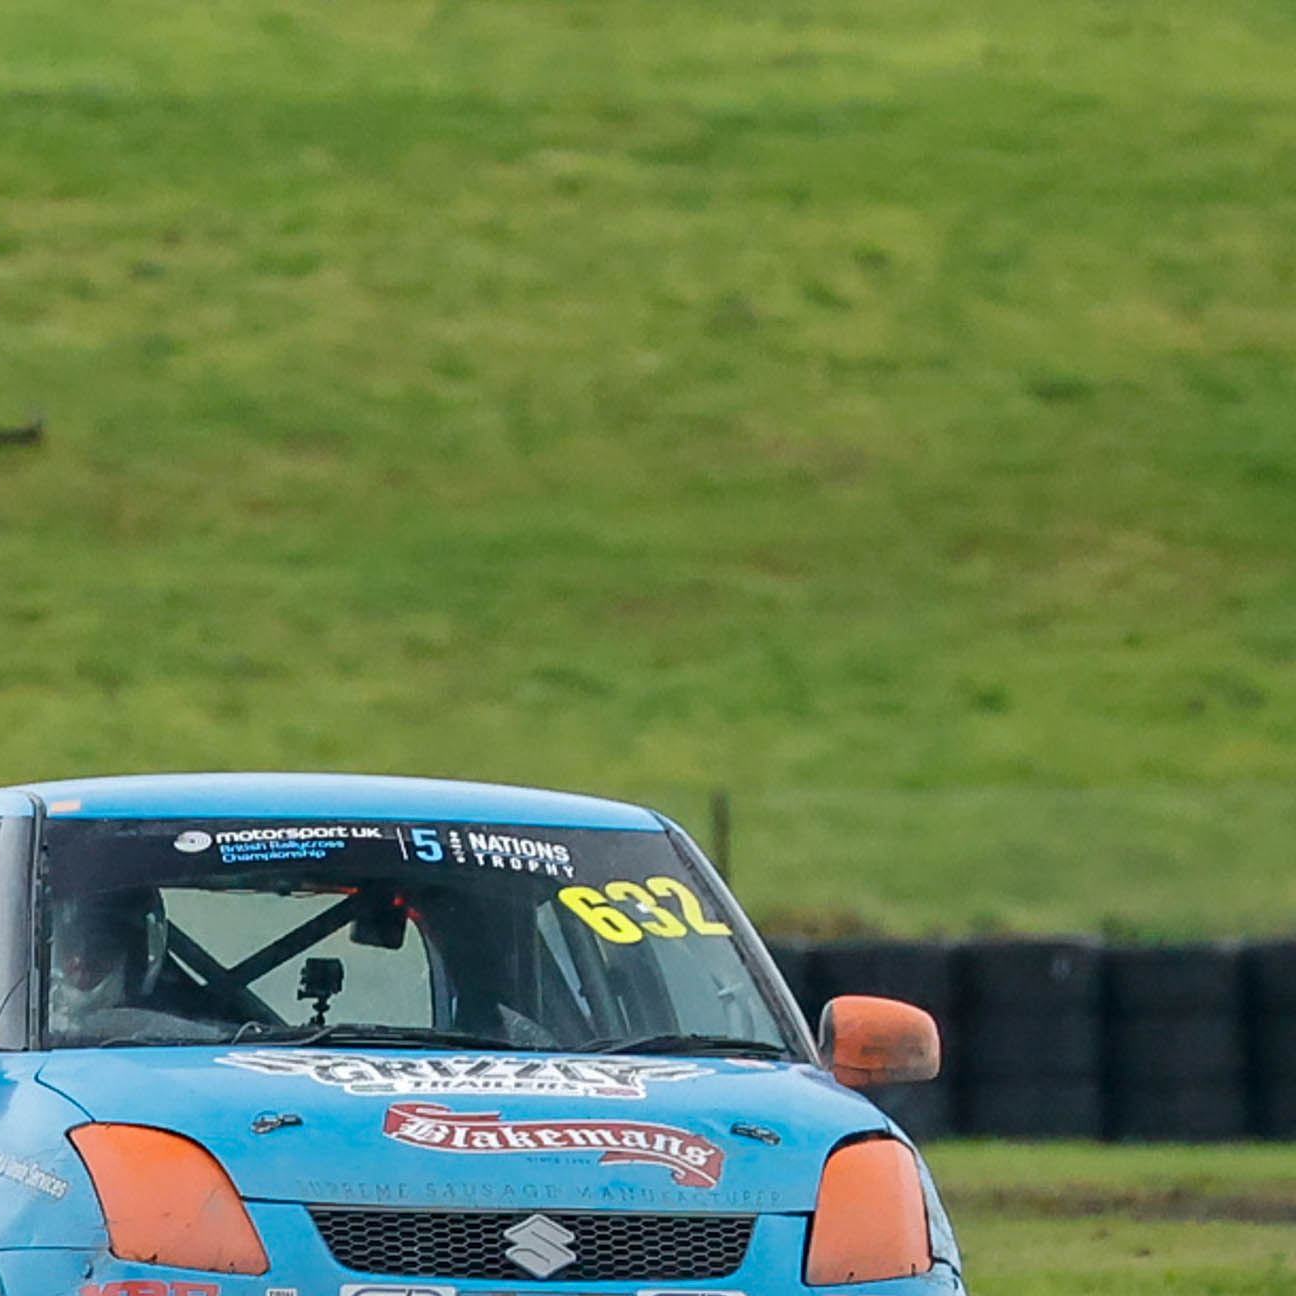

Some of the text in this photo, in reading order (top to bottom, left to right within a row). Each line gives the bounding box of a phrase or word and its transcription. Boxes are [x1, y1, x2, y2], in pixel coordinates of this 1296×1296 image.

[215, 826, 349, 844] motorsport
[220, 839, 345, 854] British Rallycross
[410, 828, 444, 863] 5
[467, 831, 571, 865] NATIONS
[221, 849, 326, 864] Championship
[474, 852, 576, 879] TROPHY
[558, 876, 734, 944] 632
[392, 1113, 715, 1167] Blakemans
